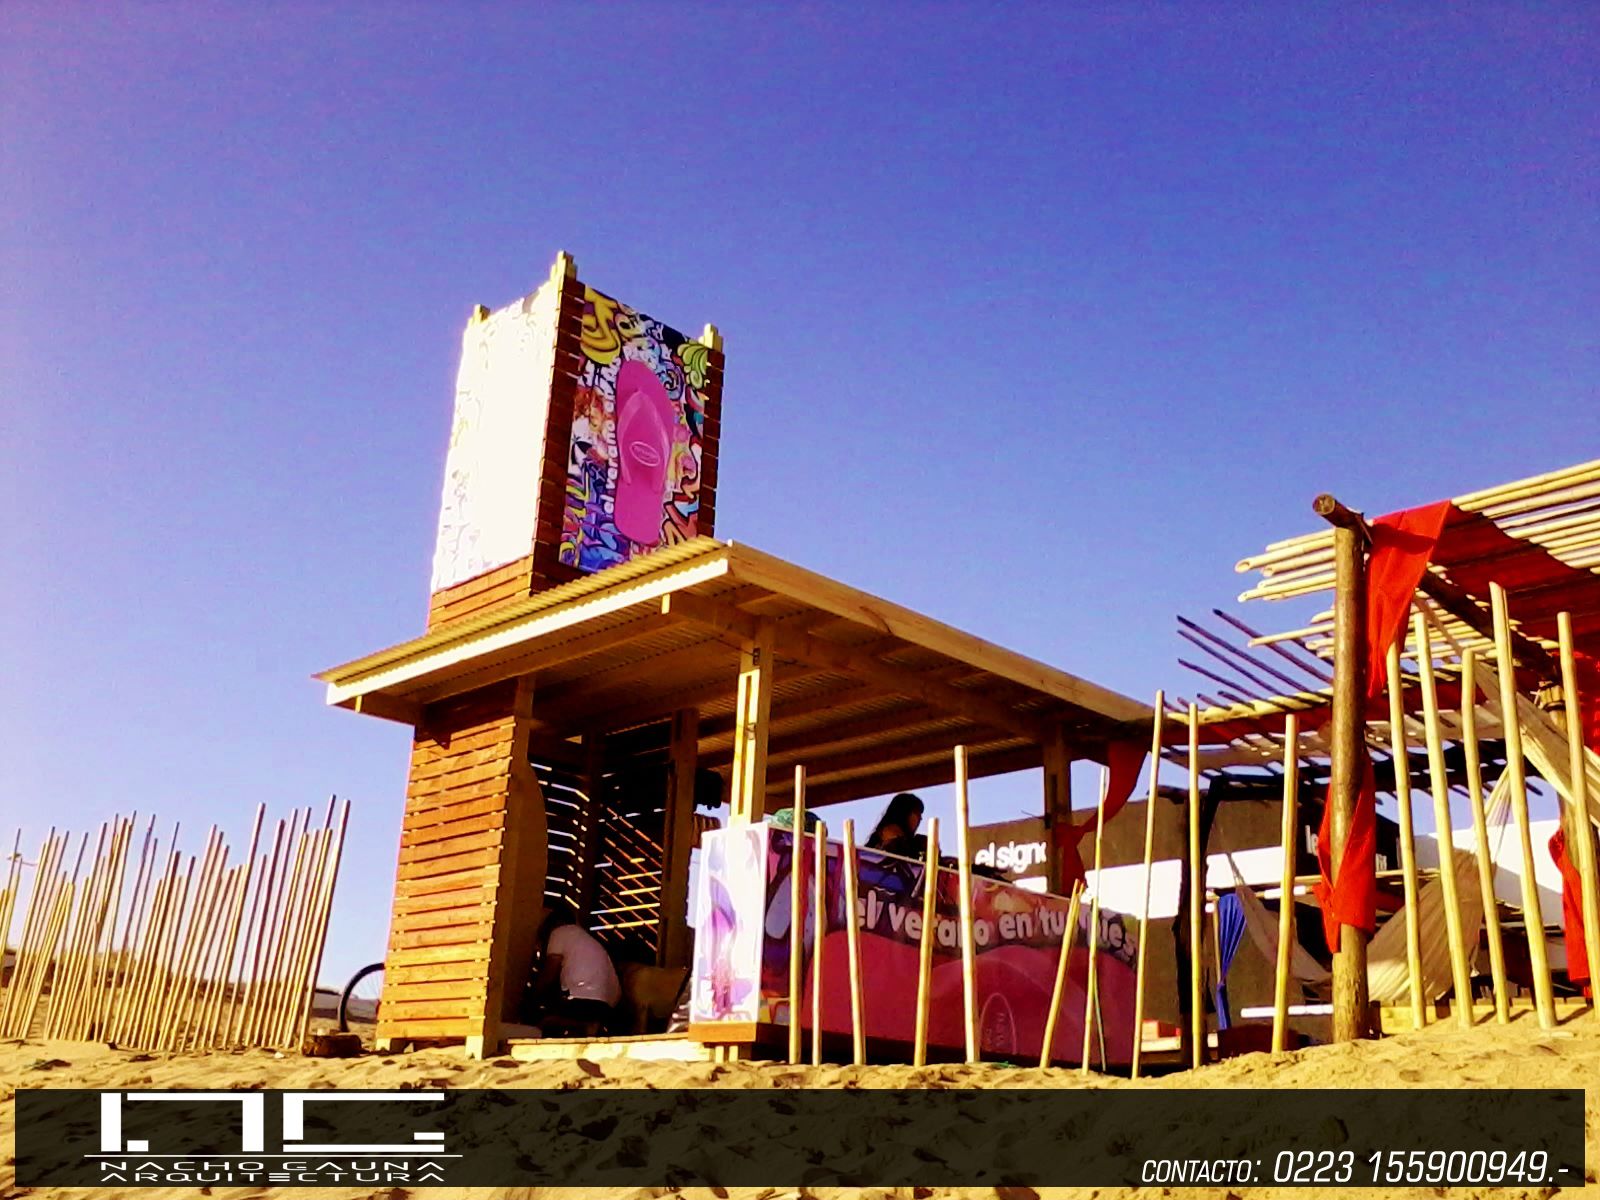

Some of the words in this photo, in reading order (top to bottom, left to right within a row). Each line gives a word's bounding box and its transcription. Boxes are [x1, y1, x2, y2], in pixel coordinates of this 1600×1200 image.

[605, 420, 619, 489] verano
[888, 903, 990, 947] veao
[999, 912, 1034, 940] en
[1039, 905, 1079, 940] tu
